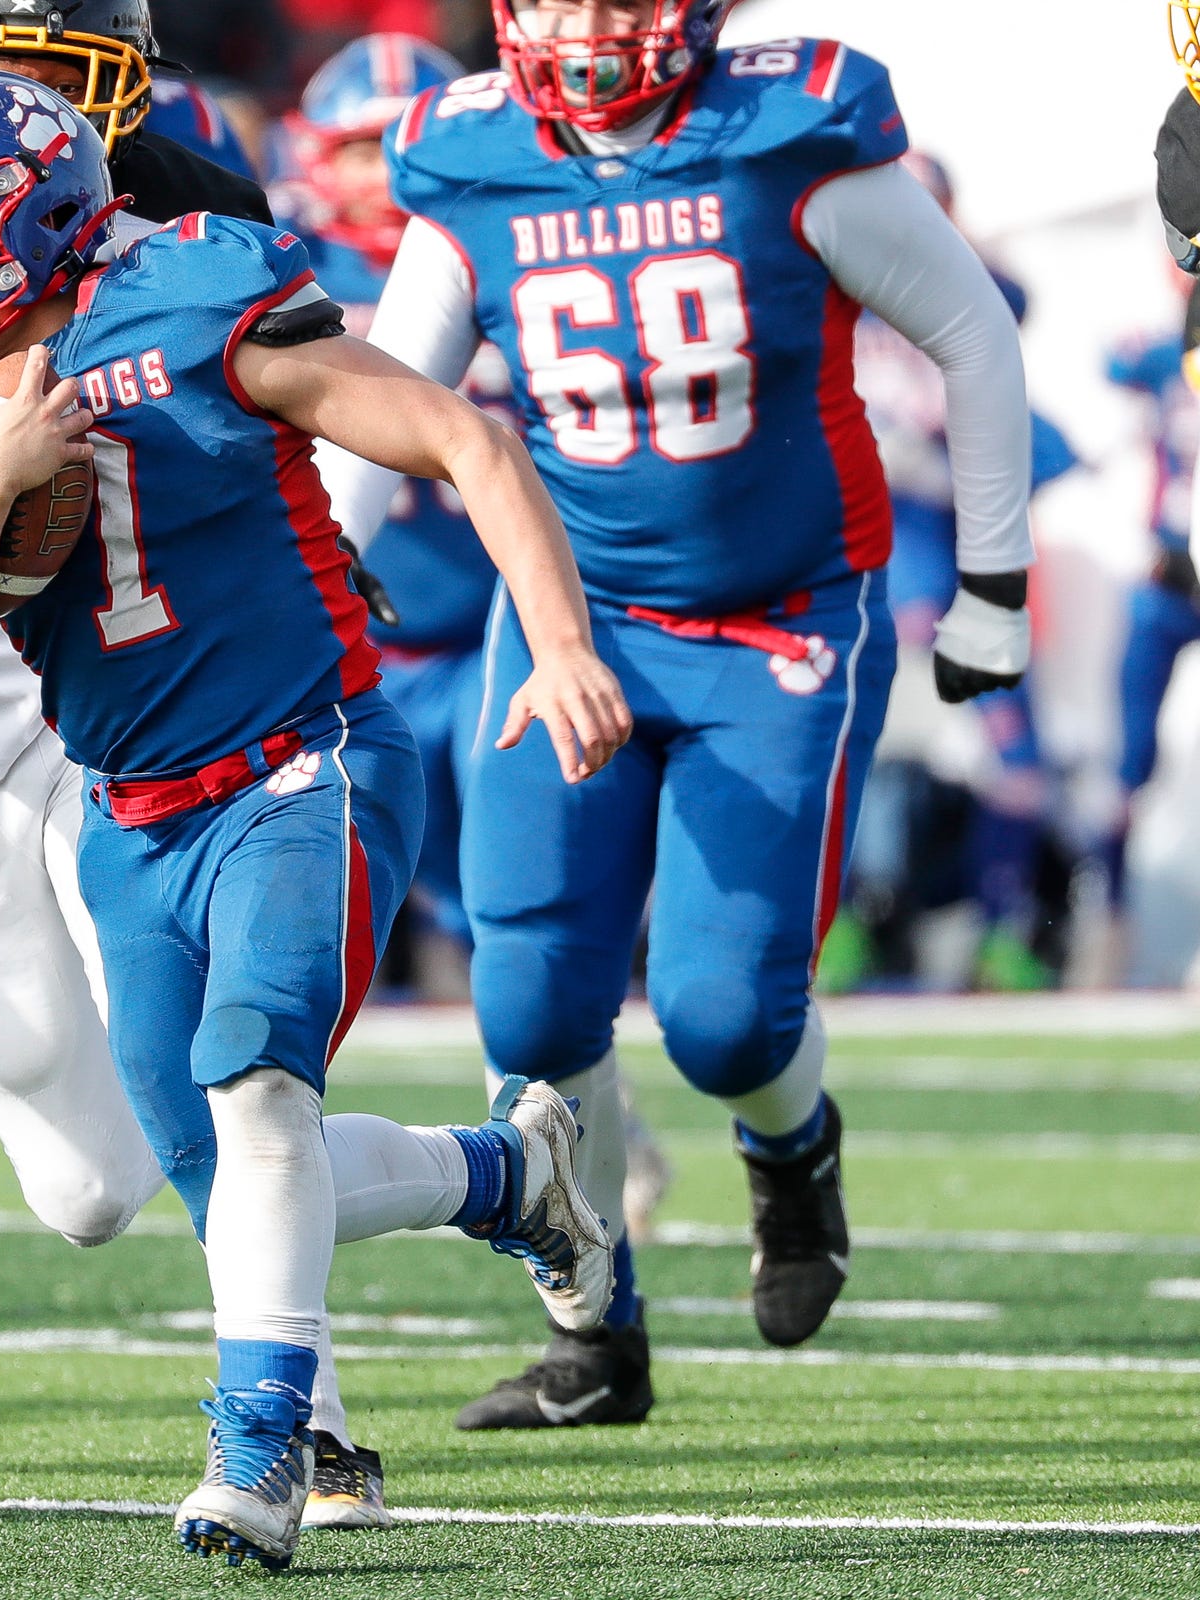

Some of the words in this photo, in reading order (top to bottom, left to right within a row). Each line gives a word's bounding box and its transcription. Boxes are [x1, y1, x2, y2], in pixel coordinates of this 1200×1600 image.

[510, 193, 724, 266] BULLDOGS
[510, 247, 758, 464] 68
[87, 424, 182, 653] 1
